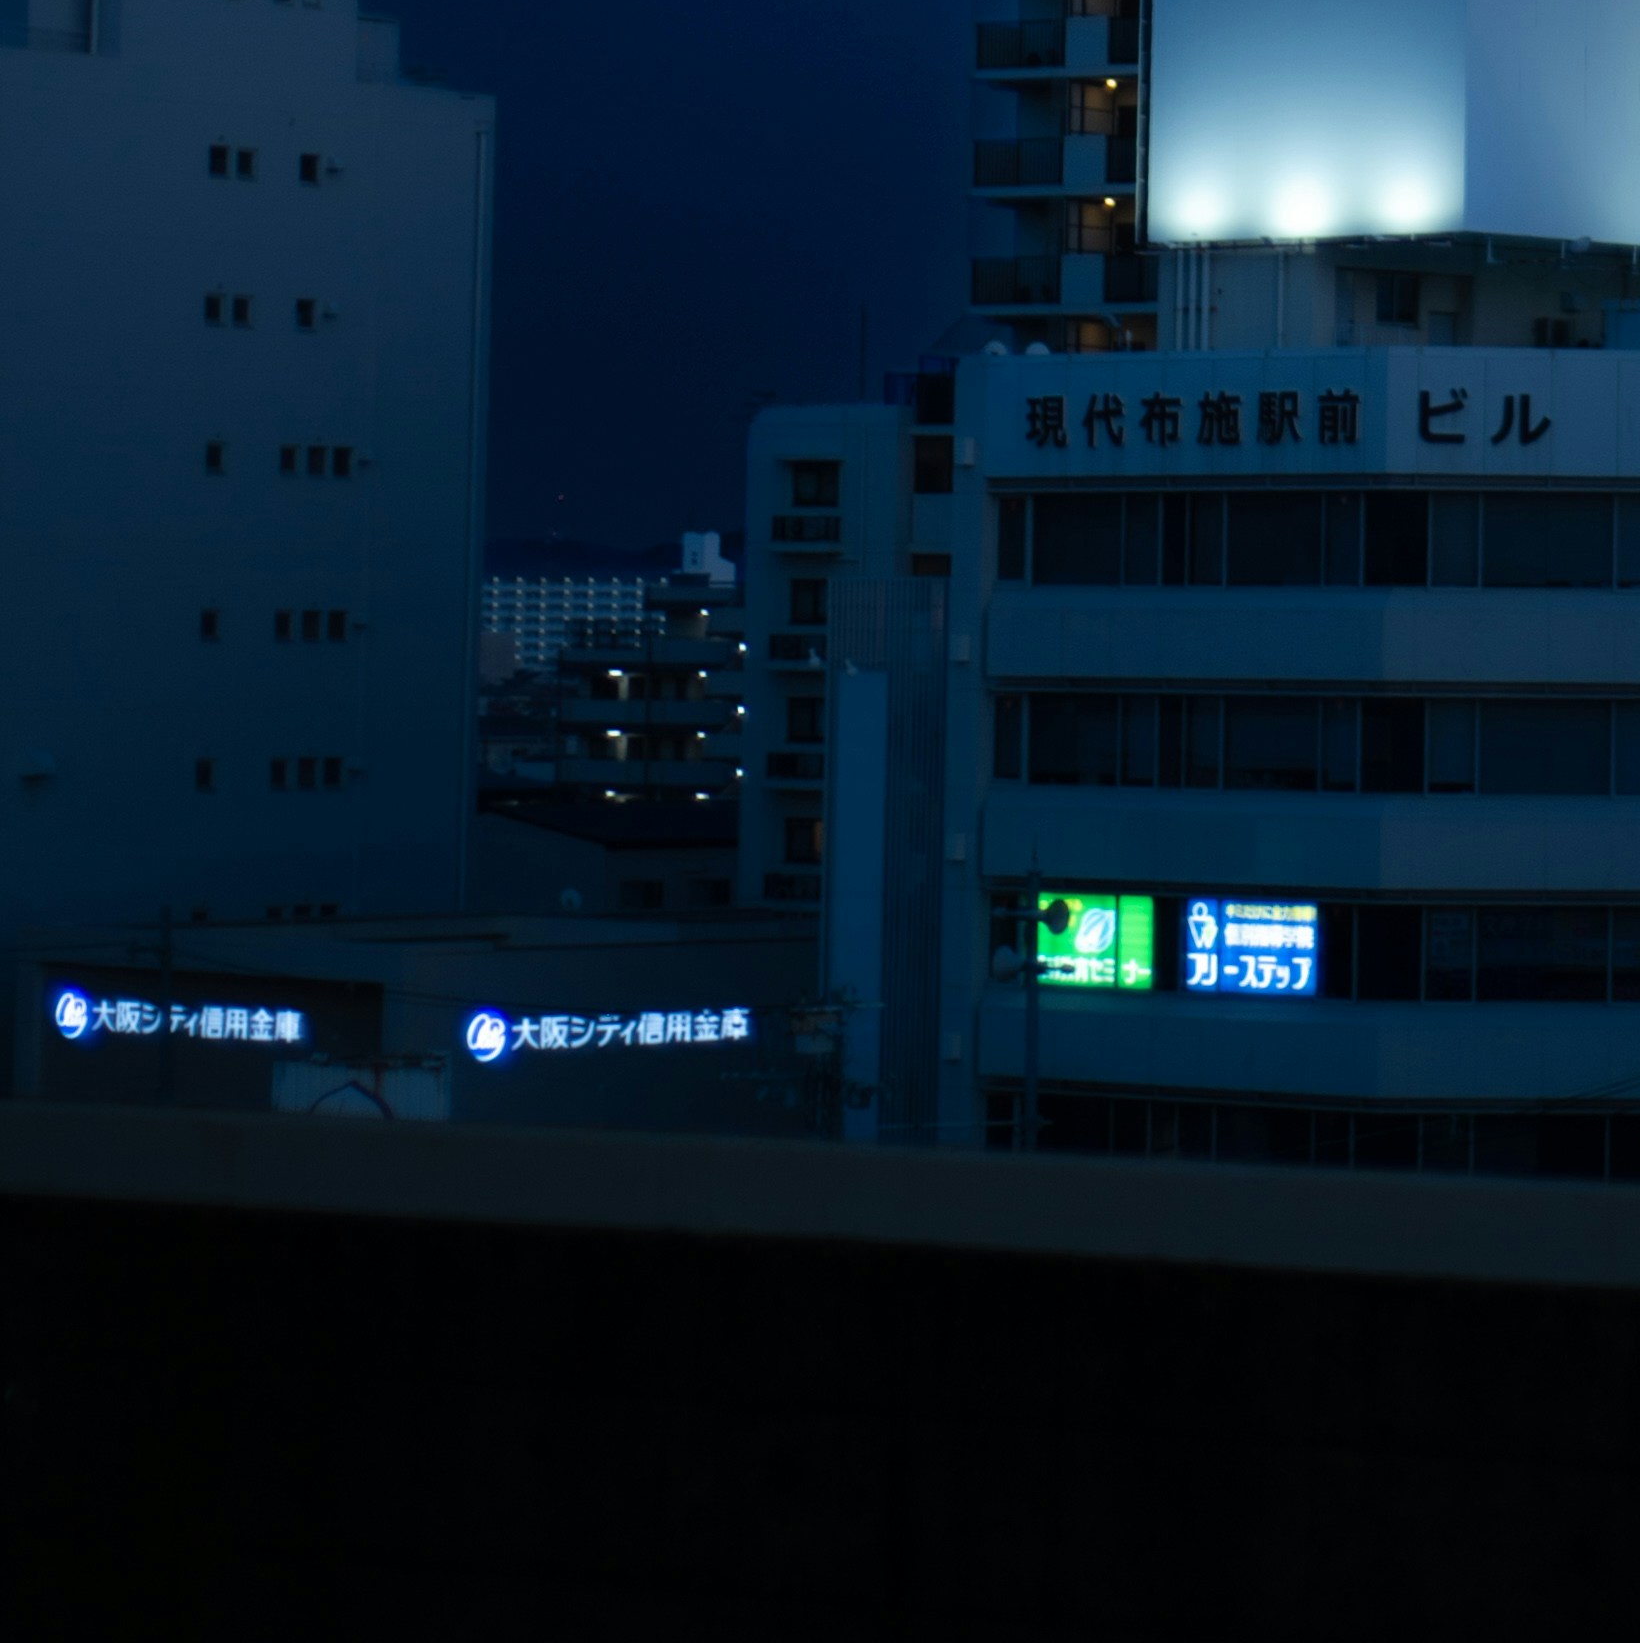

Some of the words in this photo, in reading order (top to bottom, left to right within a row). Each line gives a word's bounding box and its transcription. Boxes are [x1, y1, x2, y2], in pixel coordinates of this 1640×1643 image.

[1187, 953, 1312, 990] フリーステップ
[92, 999, 302, 1043] 大阪シティ信用金庫
[511, 1007, 749, 1051] 大阪シティ信用金庫
